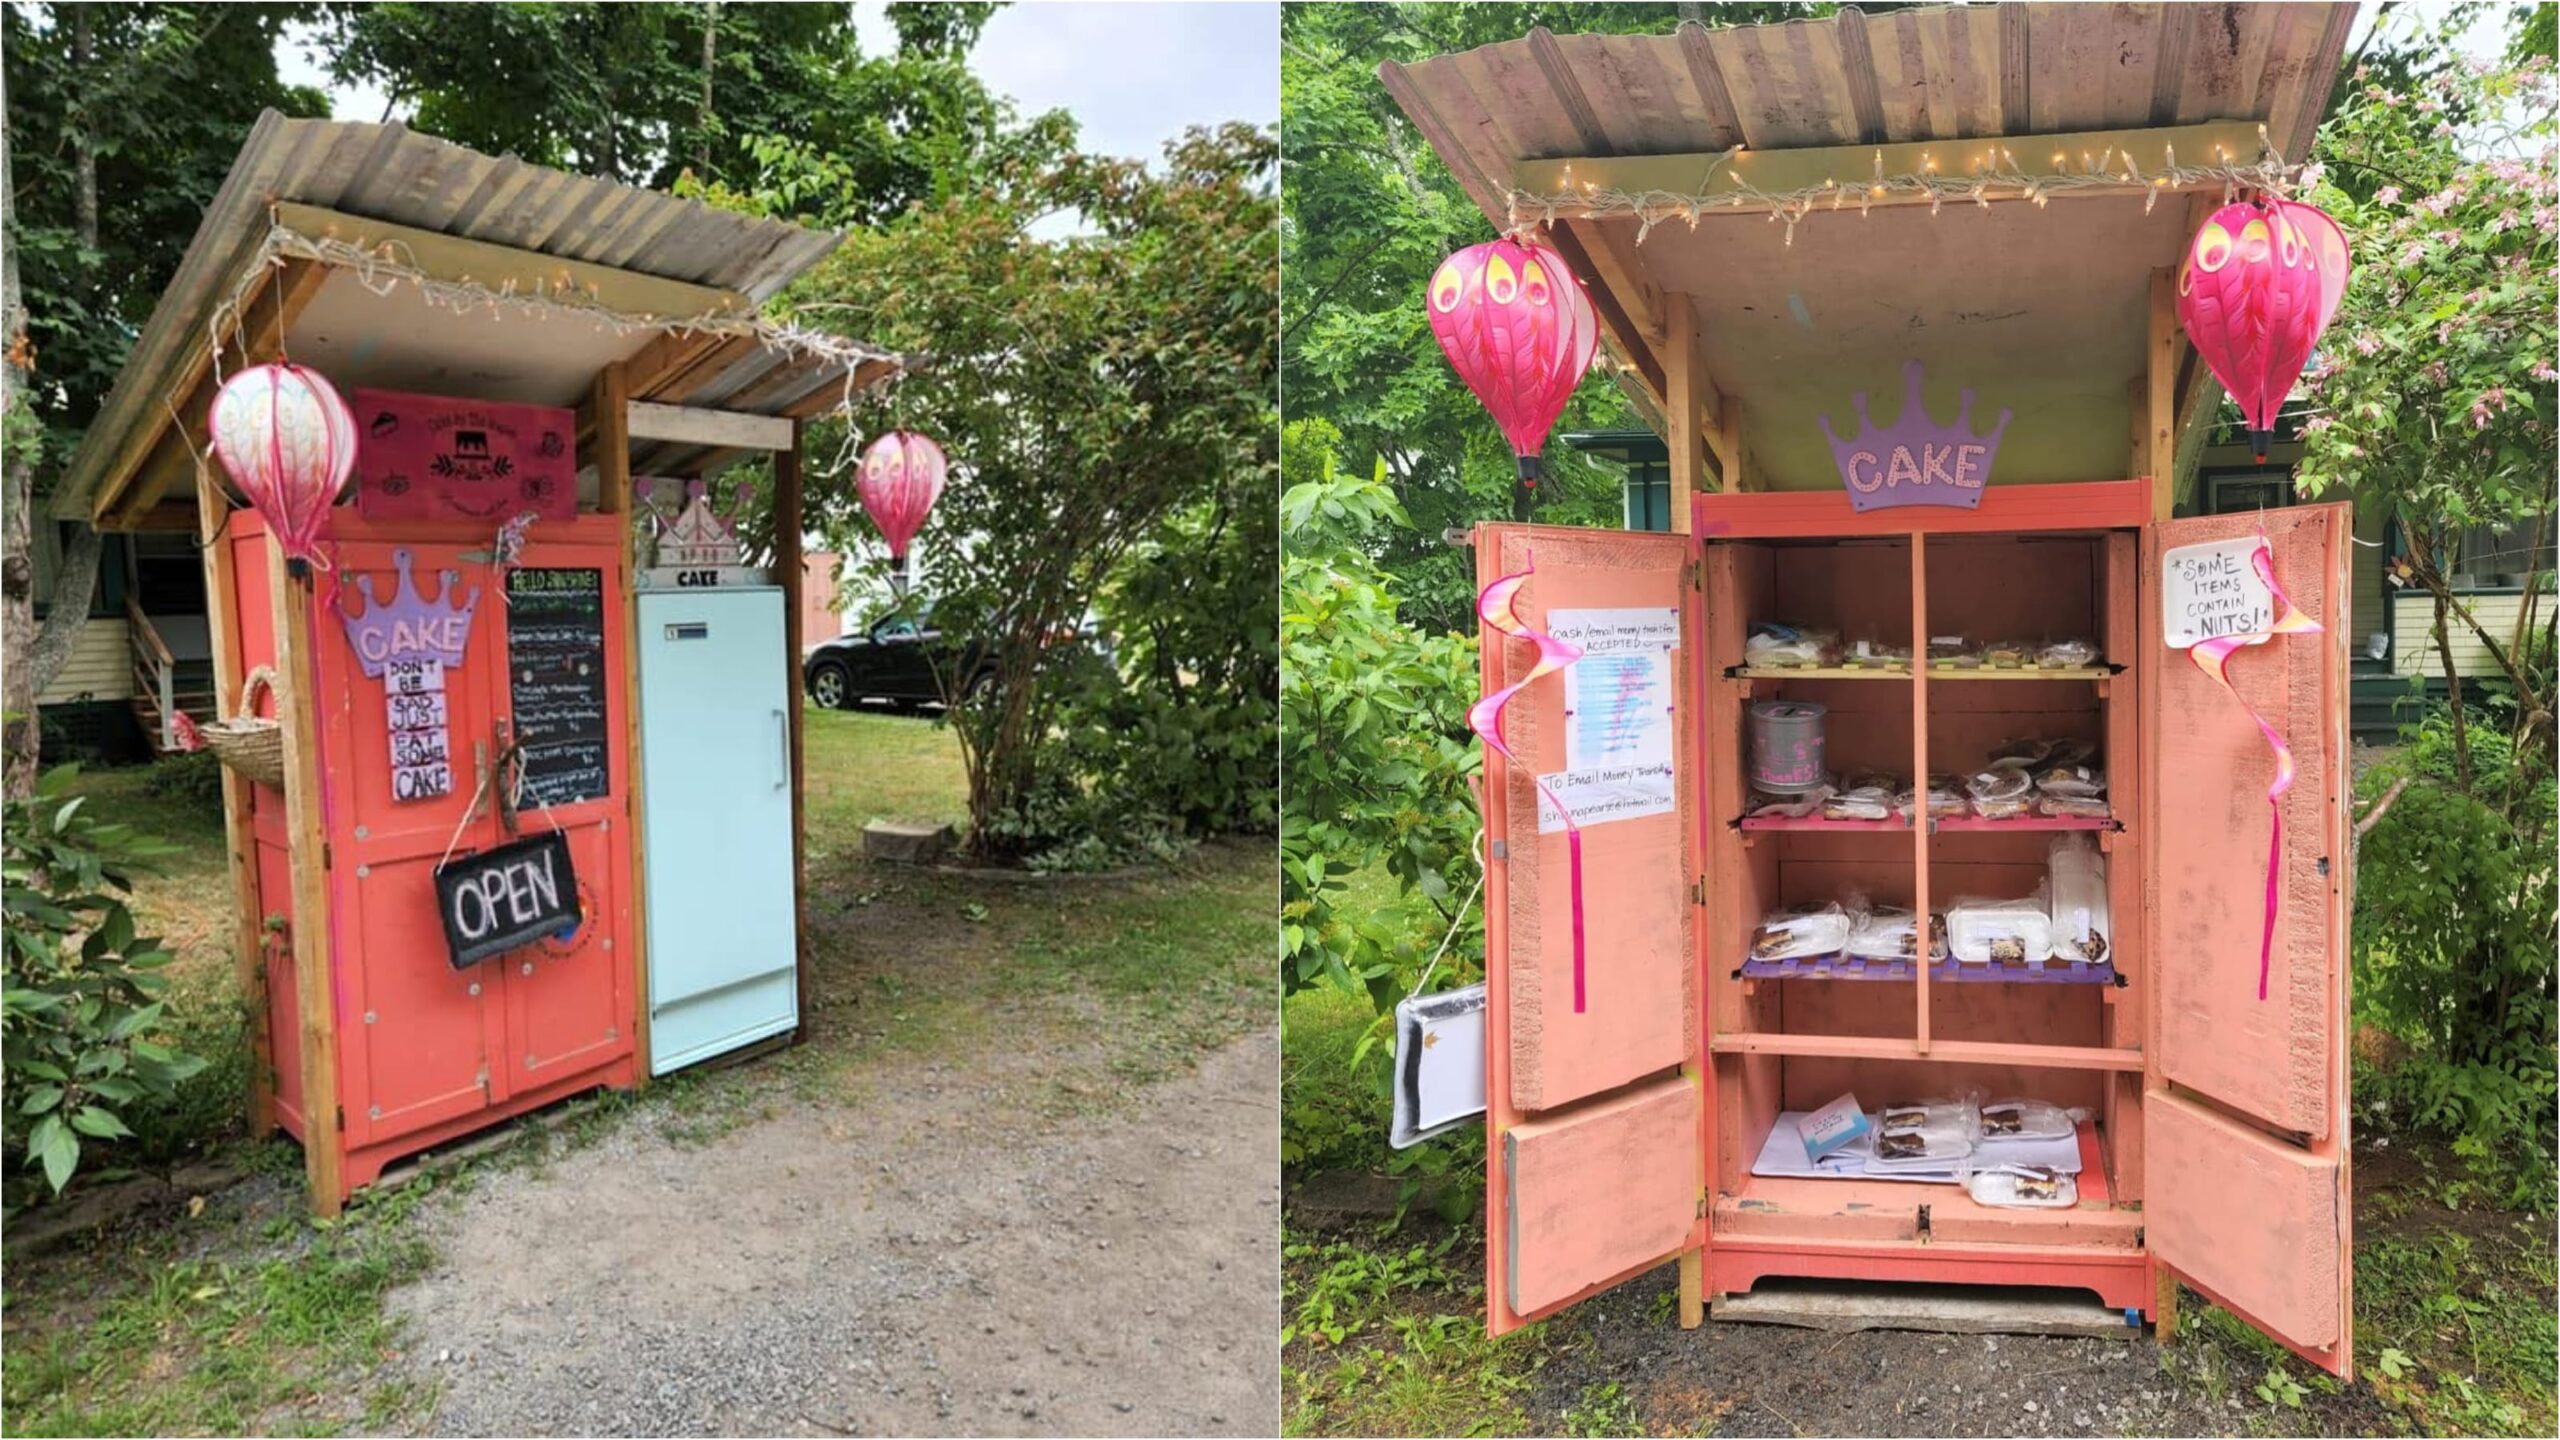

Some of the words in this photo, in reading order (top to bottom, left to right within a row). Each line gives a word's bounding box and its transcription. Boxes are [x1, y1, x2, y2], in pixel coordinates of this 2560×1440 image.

[1848, 443, 1986, 493] CAKE
[678, 570, 719, 587] CAKE
[2183, 556, 2241, 581] SOME
[2194, 577, 2241, 596] ITEMS
[2186, 592, 2246, 618] CONTAIN
[2201, 606, 2258, 637] NUTS!
[360, 616, 464, 662] CAKE
[1586, 639, 1641, 652] ACCEPTED
[399, 675, 423, 692] BE
[394, 696, 433, 713] SAD
[392, 707, 442, 730] JUST
[396, 746, 446, 767] SOME
[396, 766, 448, 800] CAKE
[1543, 774, 1564, 790] To
[1567, 770, 1600, 787] Email
[1602, 768, 1635, 785] Money
[455, 848, 560, 939] OPEN
